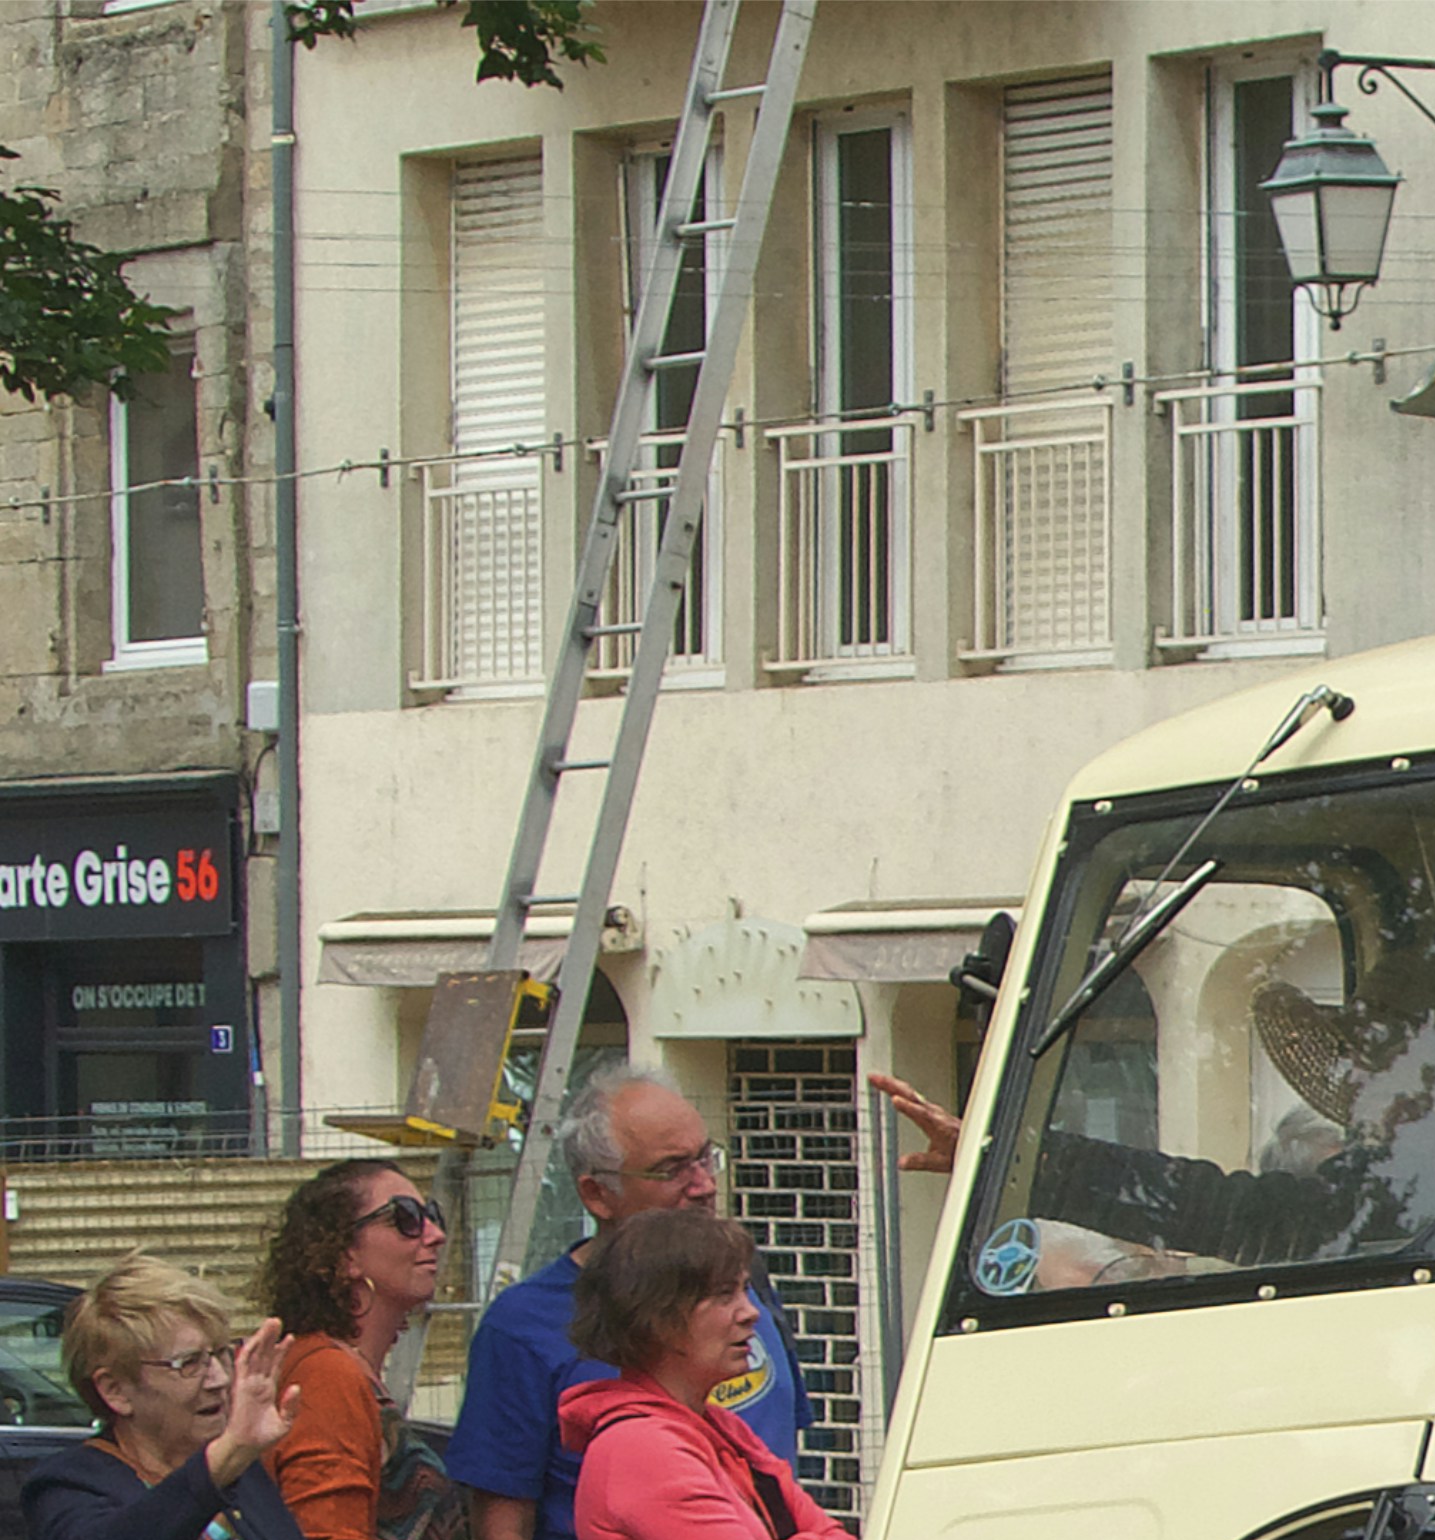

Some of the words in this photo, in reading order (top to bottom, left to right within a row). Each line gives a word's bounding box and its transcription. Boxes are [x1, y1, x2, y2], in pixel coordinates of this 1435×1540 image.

[0, 853, 69, 908] arte
[75, 845, 171, 906] Grise
[177, 849, 219, 902] 56
[73, 985, 96, 1009] ON
[98, 983, 173, 1008] S'OCCUPE
[176, 982, 195, 1006] DE
[218, 1030, 228, 1048] 3
[714, 1376, 752, 1402] Club
